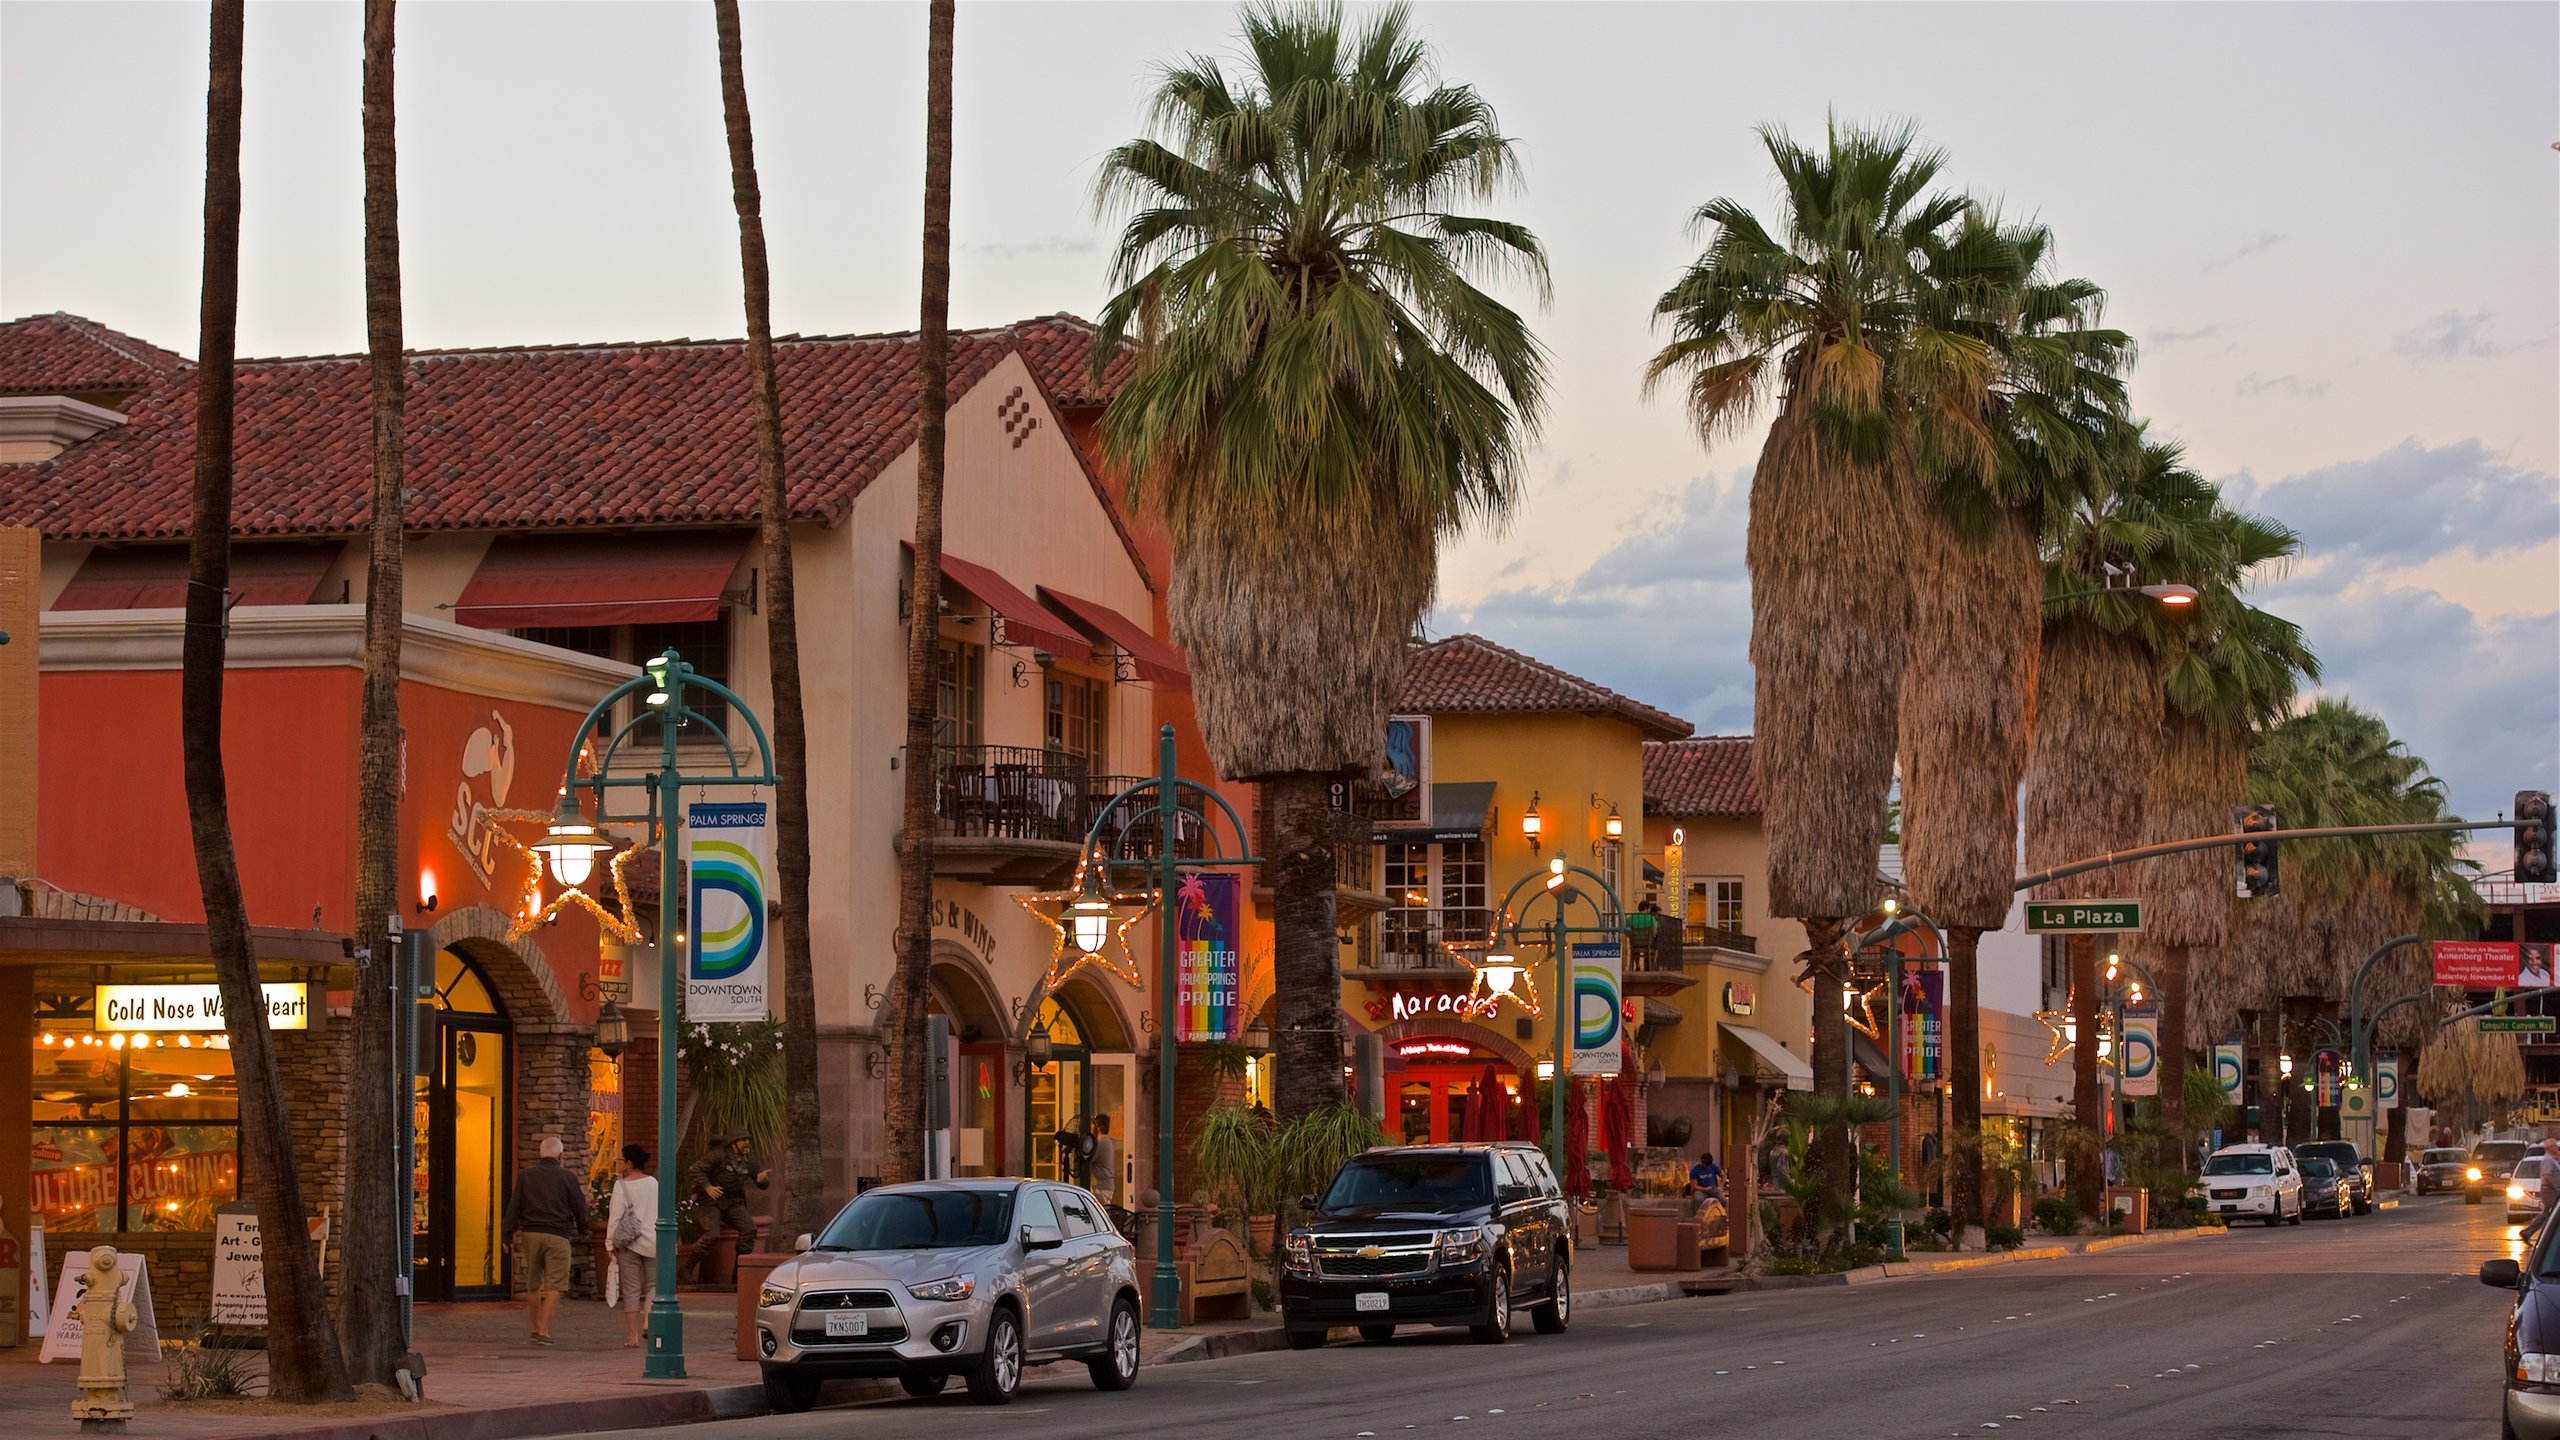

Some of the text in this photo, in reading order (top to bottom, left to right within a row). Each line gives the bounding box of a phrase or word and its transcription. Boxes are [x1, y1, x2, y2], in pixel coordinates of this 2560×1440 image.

[690, 813, 765, 825] PALM SPRINGS
[2043, 910, 2124, 924] La Plaza
[948, 901, 959, 928] &
[964, 908, 996, 965] WINE
[1592, 949, 1620, 957] SPRINGS
[2437, 952, 2515, 962] Annenberg Theater
[1180, 951, 1236, 968] GREATER
[1180, 973, 1237, 985] PALM SPRINGS
[2470, 973, 2505, 981] November
[690, 984, 762, 995] DOWNTOWN
[730, 996, 762, 1004] SOUTH
[1180, 991, 1237, 1007] PRIDE
[108, 999, 145, 1021] Cold
[153, 997, 195, 1019] Nose
[1905, 1021, 1941, 1031] GREATER
[2511, 1021, 2536, 1030] Canyon
[2539, 1022, 2553, 1030] Way
[1573, 1051, 1618, 1059] DOWNTOWN
[1904, 1047, 1942, 1057] PRIDE
[130, 1153, 236, 1200] CLOTHING
[221, 1237, 240, 1246] Art
[828, 1321, 864, 1333] 7KNS007
